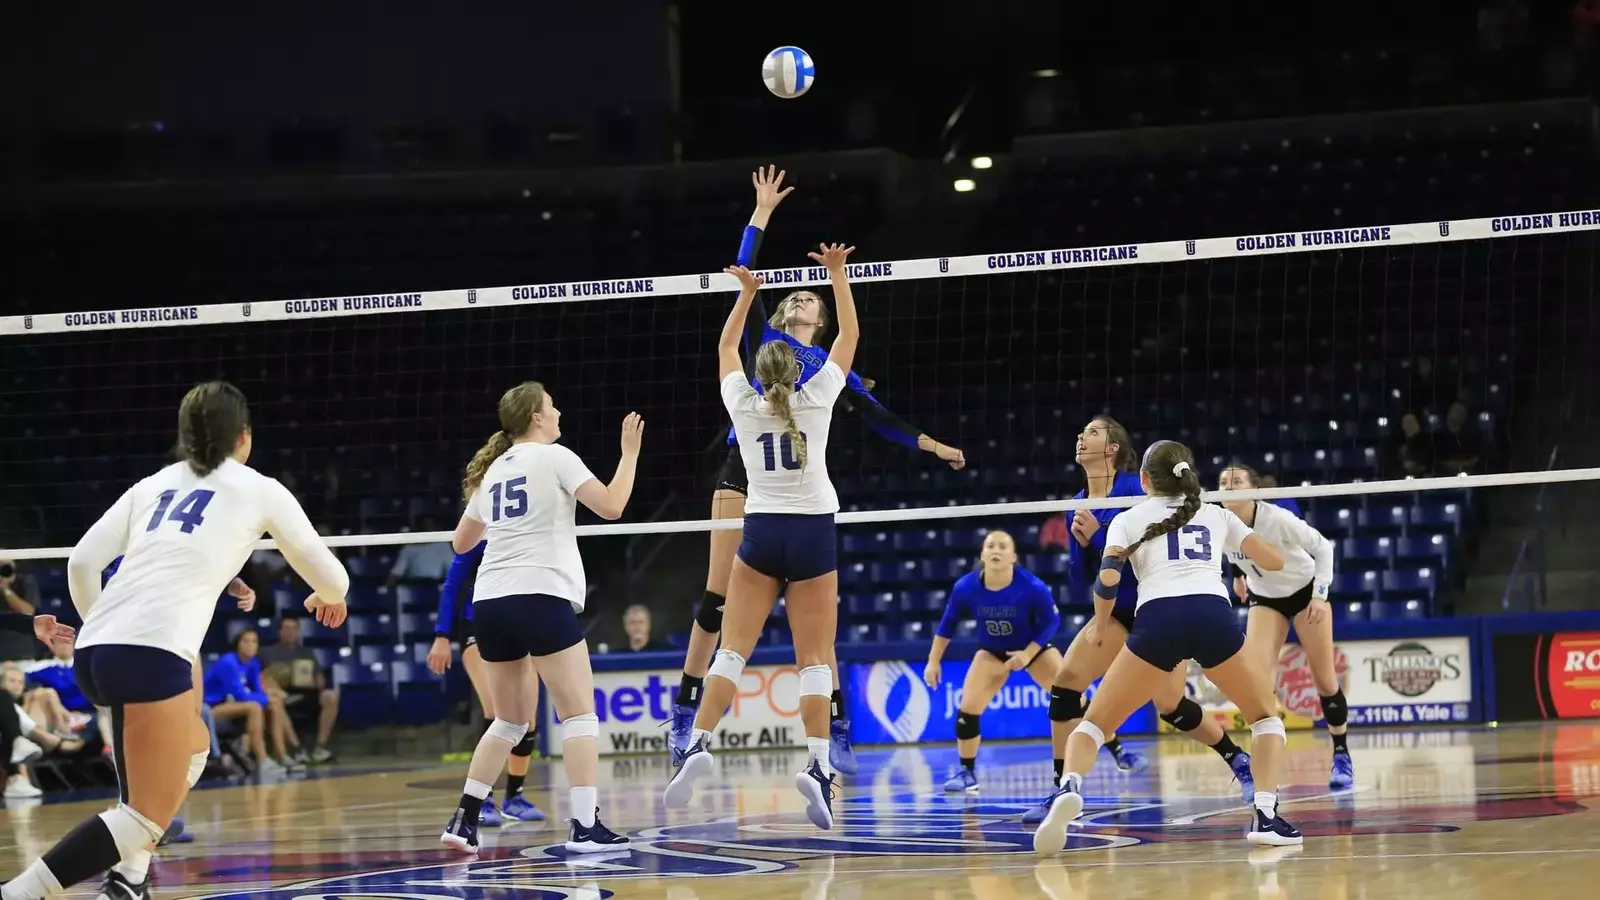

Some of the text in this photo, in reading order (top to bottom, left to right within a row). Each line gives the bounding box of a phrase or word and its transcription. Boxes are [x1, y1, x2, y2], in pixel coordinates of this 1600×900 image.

[1491, 215, 1553, 232] GOLDEN
[1236, 227, 1391, 251] GOLDEN HURRICANE
[987, 245, 1138, 269] GOLDEN HURRICANE
[751, 263, 892, 285] OLDEN HUICANE
[512, 279, 653, 300] GOLDEN HURRICANE
[285, 294, 422, 314] GOLDEN HURRICANE
[65, 307, 198, 326] GOLDEN HURRICANE
[756, 431, 808, 471] 10
[489, 476, 528, 522] 15
[146, 489, 216, 535] 14
[1167, 524, 1212, 562] 13
[1231, 551, 1252, 560] TUL
[1564, 649, 1600, 672] RO
[1364, 706, 1400, 723] 11th
[1400, 704, 1415, 721] &
[1415, 704, 1450, 721] Yale
[610, 725, 794, 750] Wirel for All.
